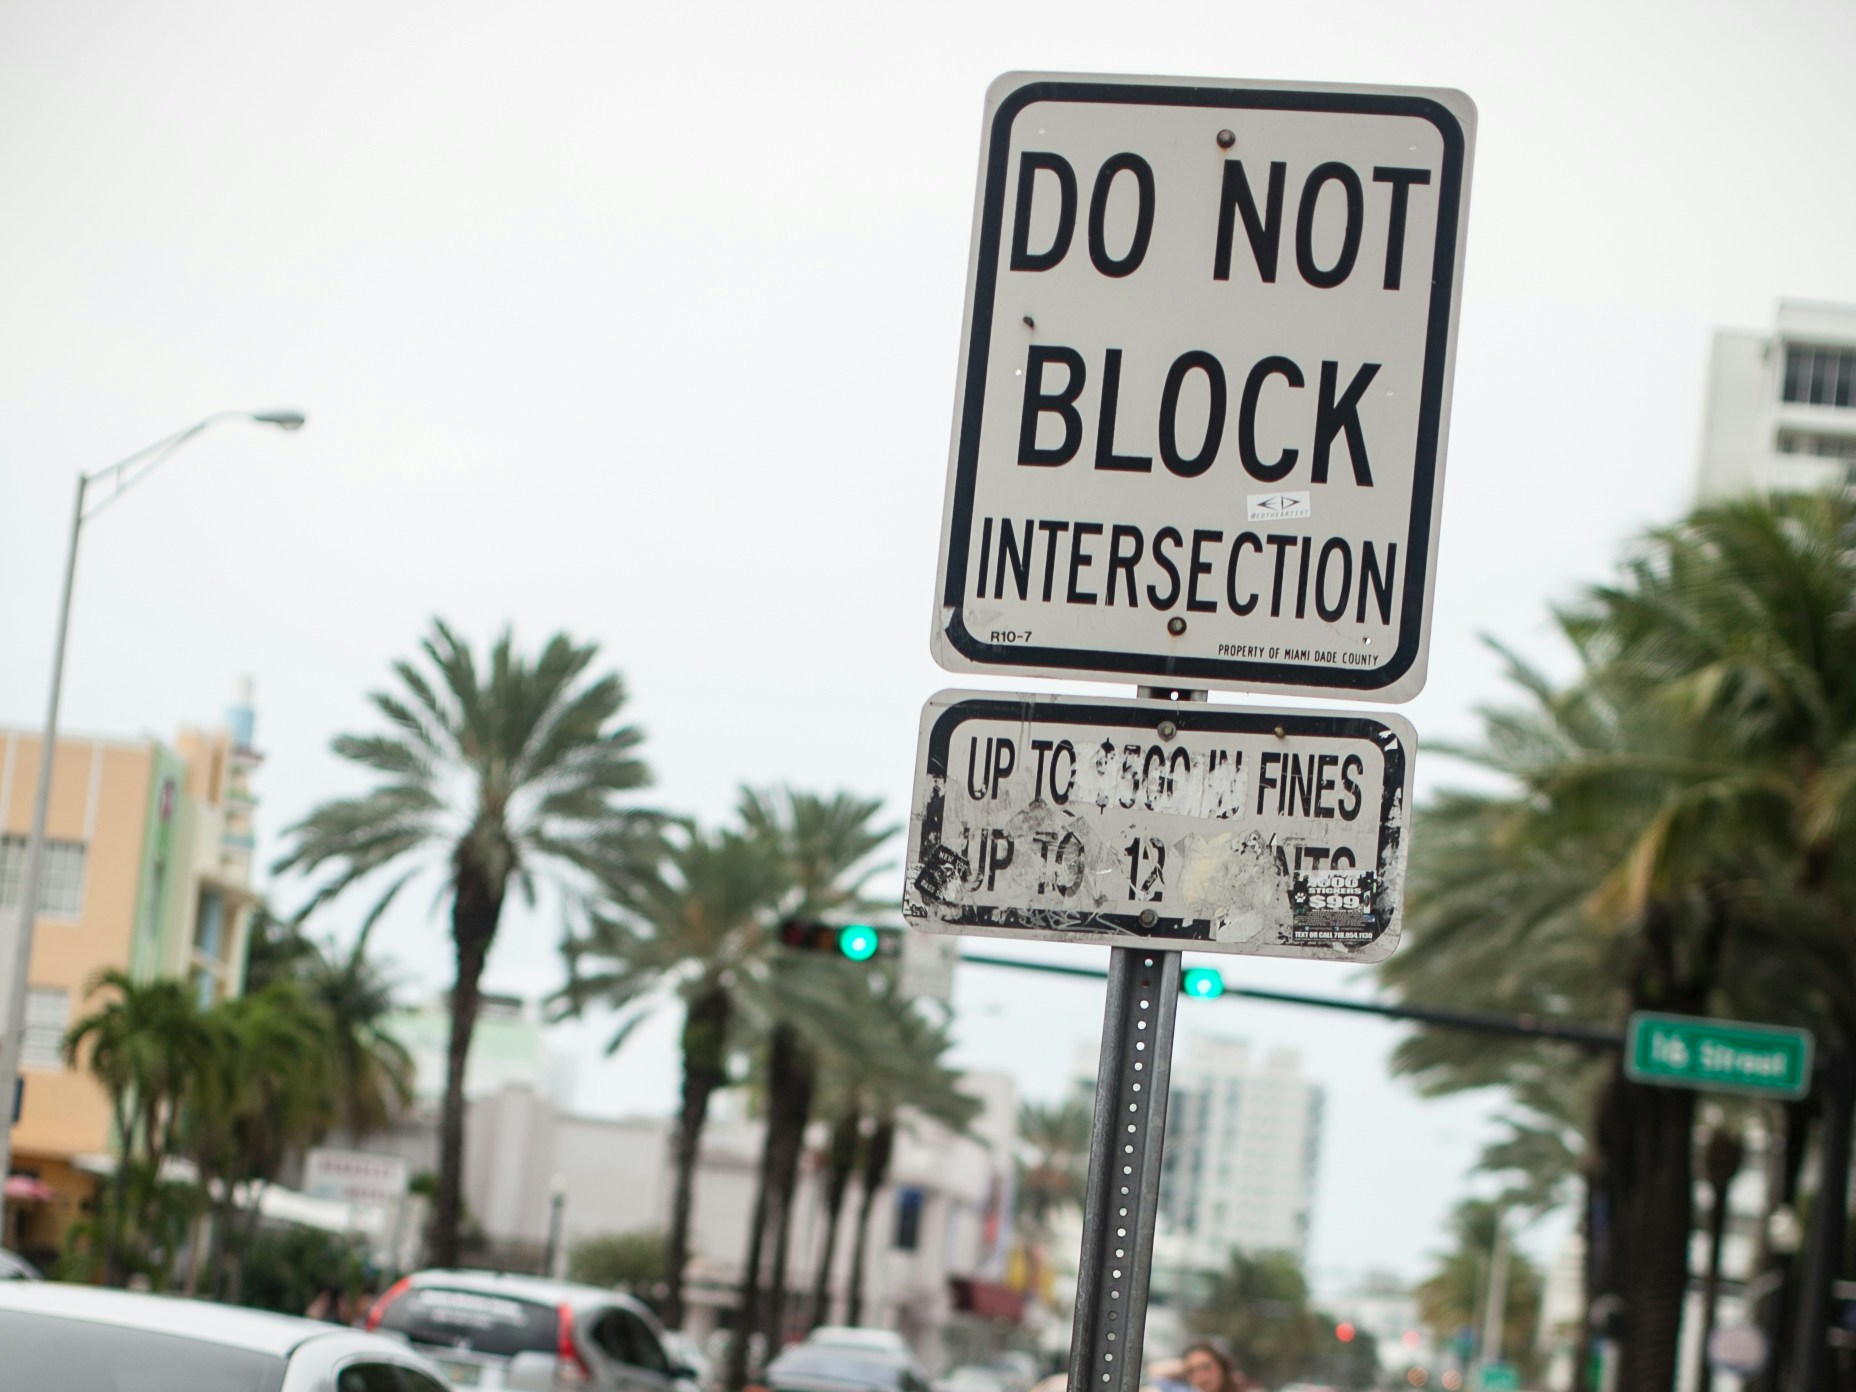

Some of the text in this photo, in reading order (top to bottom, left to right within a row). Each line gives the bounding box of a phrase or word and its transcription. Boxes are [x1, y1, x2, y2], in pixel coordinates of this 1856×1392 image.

[1009, 151, 1432, 291] DO NOT
[1017, 344, 1383, 488] BLOCK
[975, 516, 1398, 626] INTERSECTION
[990, 630, 1033, 643] R10-7
[1218, 644, 1379, 666] PROPERTY OF MIAMI DADE COUNTY
[967, 736, 1015, 801] UP
[1031, 739, 1077, 805] TO
[1256, 751, 1364, 822] FINES
[939, 851, 955, 863] NEW
[961, 827, 1166, 903] UP TO 12
[1309, 895, 1360, 909] $99
